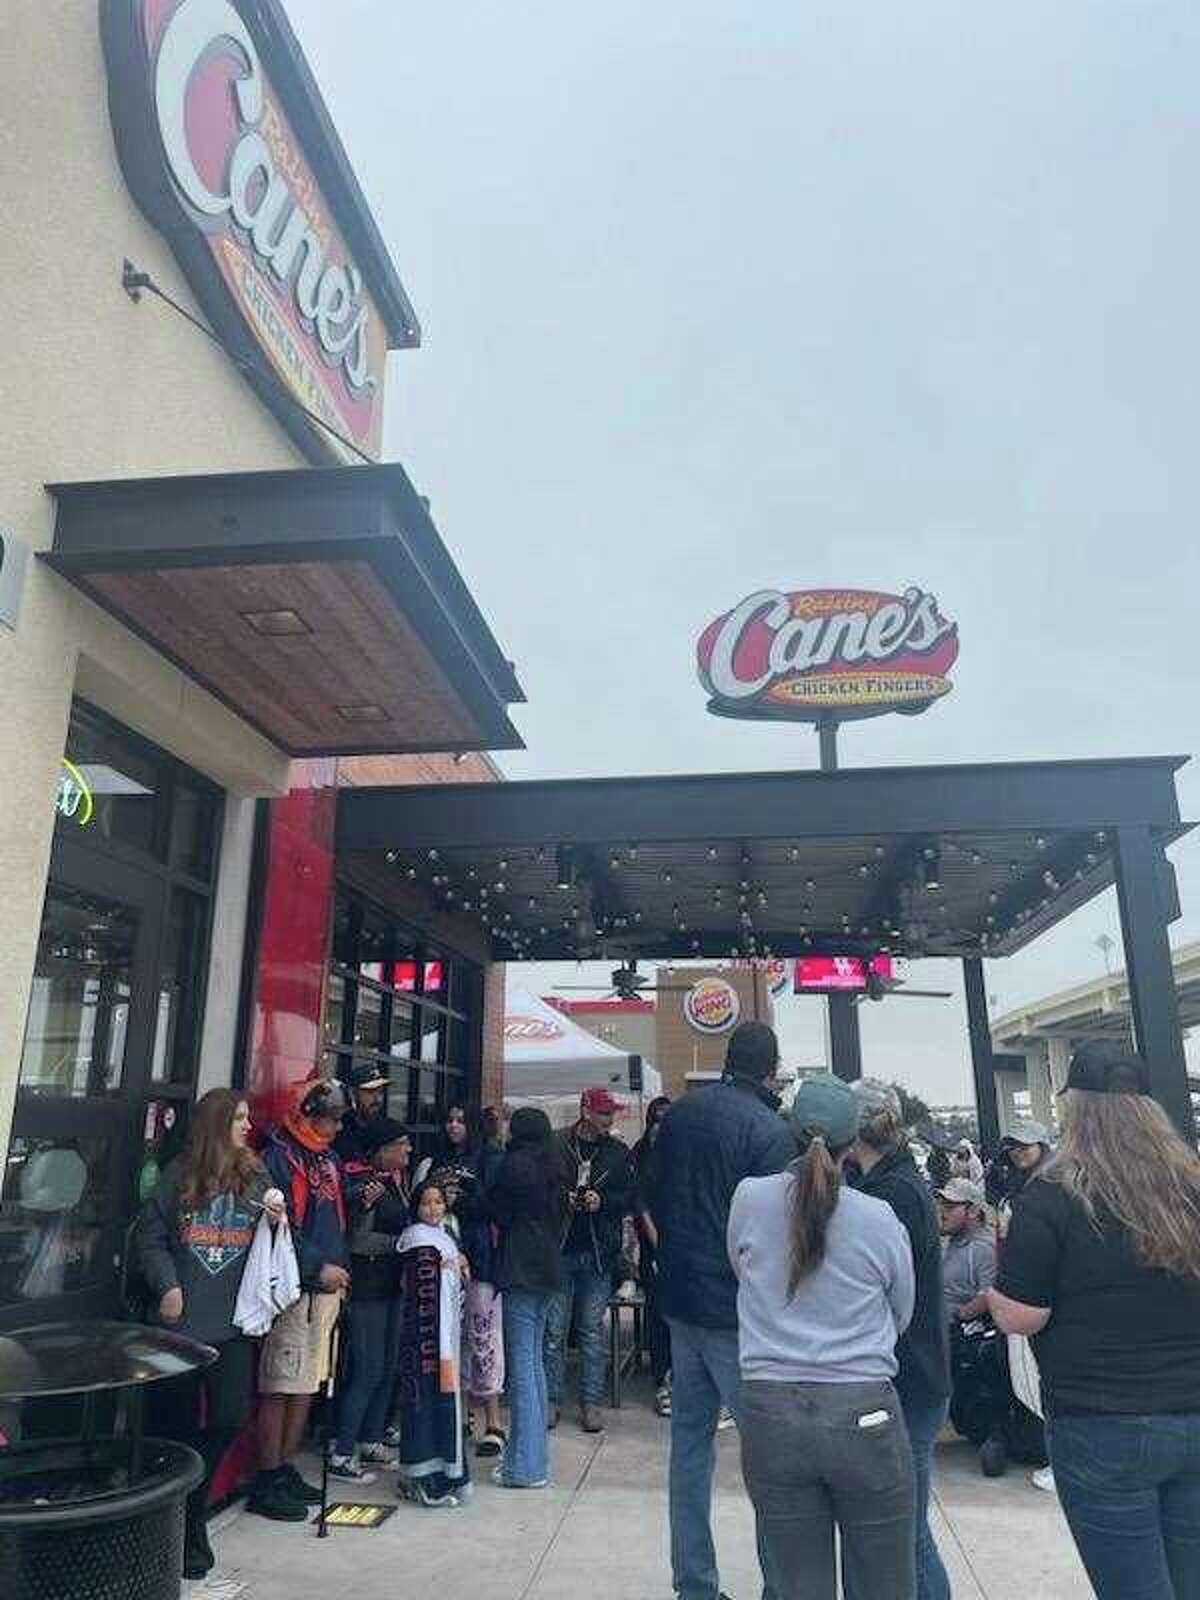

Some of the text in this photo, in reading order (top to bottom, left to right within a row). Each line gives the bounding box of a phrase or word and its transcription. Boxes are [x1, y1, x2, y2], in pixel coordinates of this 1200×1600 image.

[709, 587, 957, 698] Cane's
[791, 678, 935, 696] CHICKEN FINGERS
